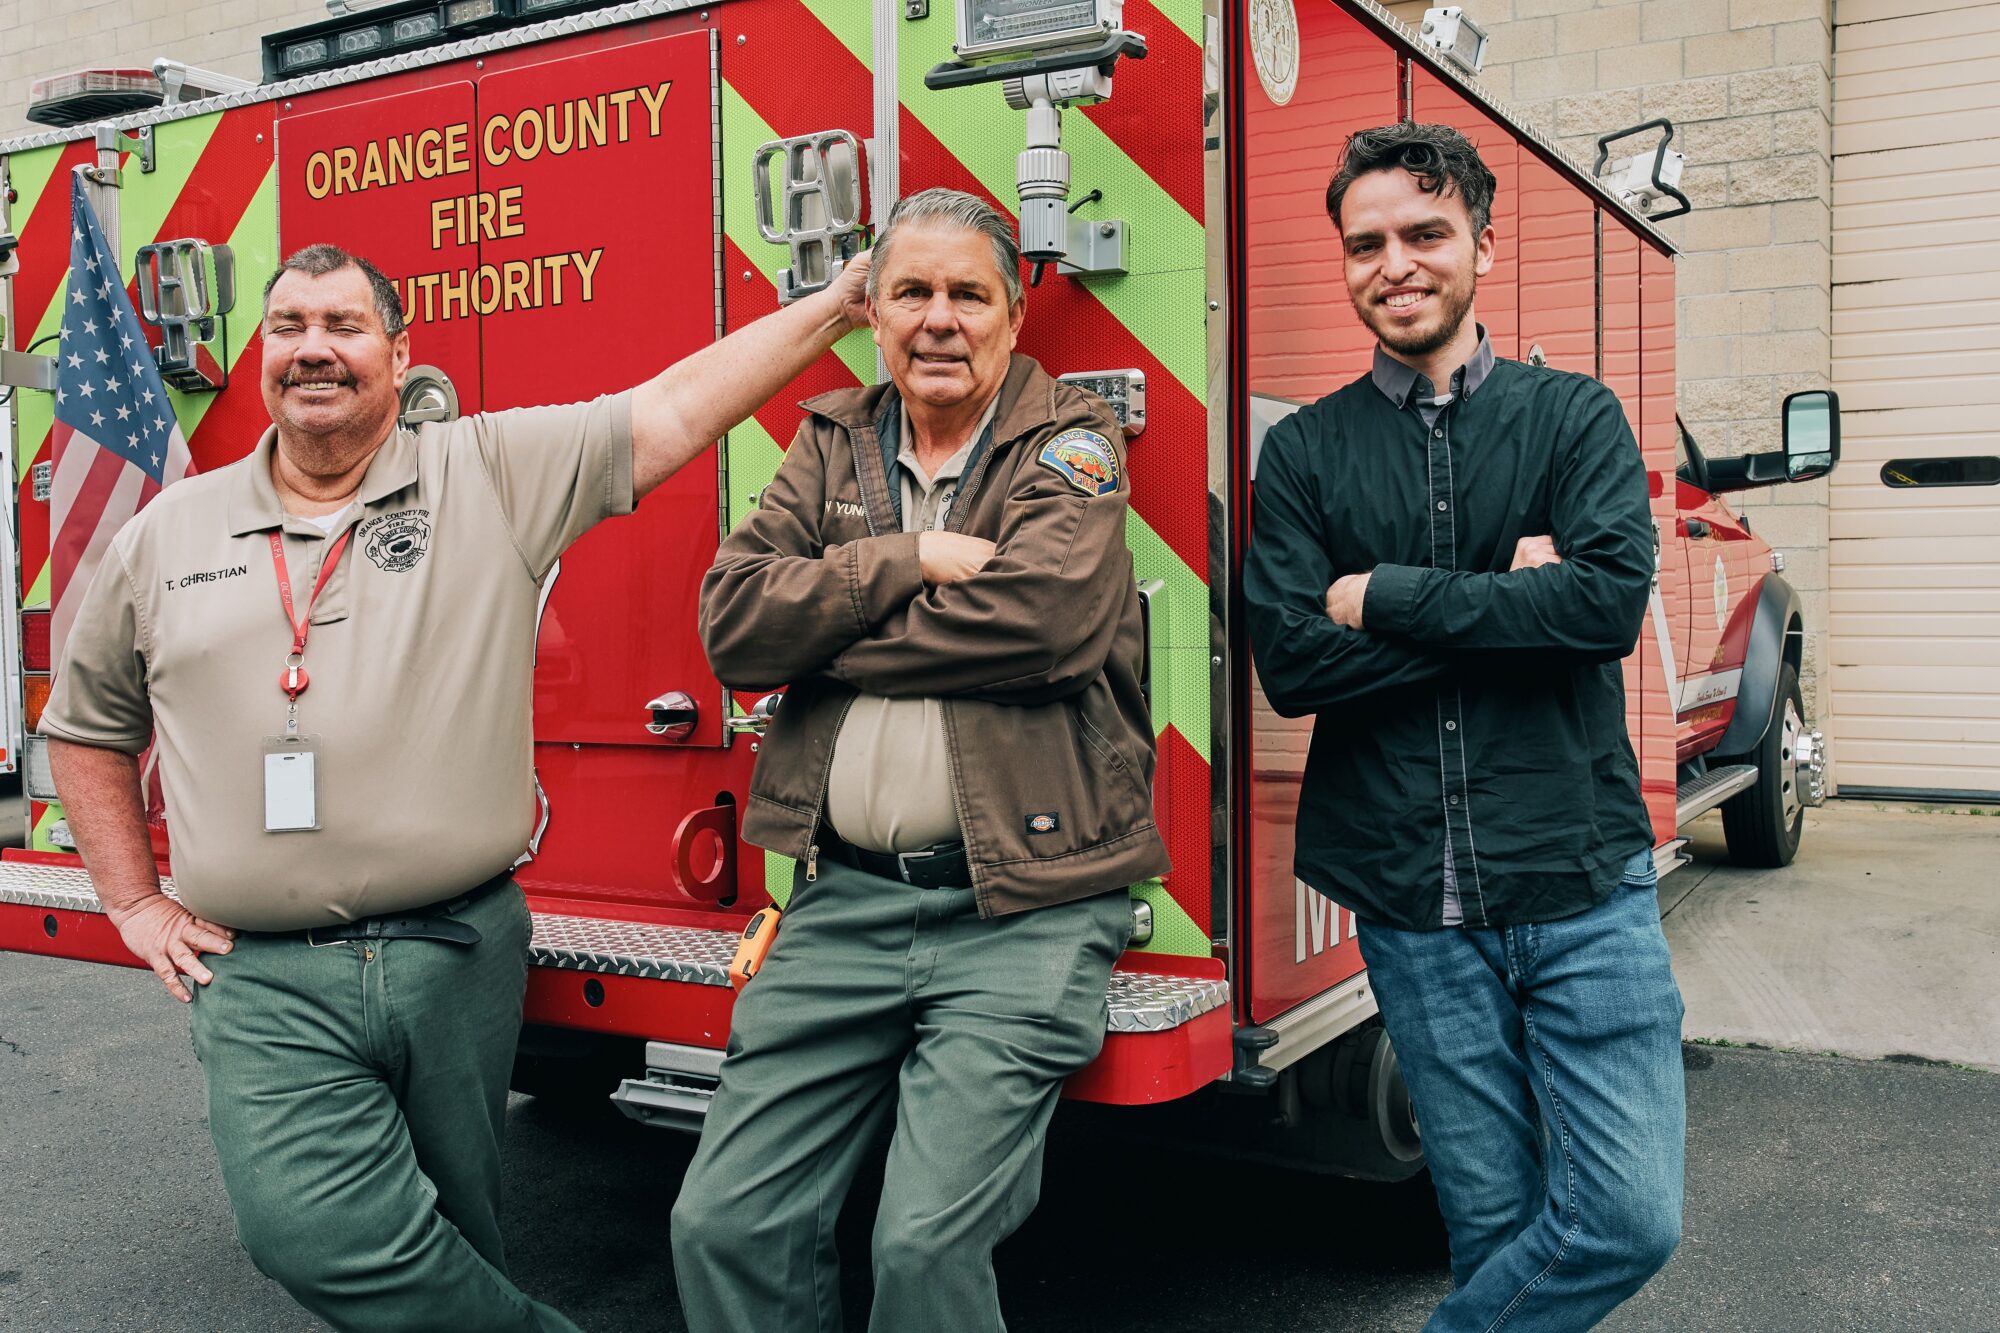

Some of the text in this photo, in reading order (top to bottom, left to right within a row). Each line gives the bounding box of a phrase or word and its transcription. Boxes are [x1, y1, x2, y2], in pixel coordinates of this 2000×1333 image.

[305, 80, 673, 200] ORANGE COUNTY
[430, 185, 526, 250] FIRE
[391, 247, 605, 327] UTHORITY
[1046, 431, 1119, 478] ORANGE COUNTY
[1073, 472, 1100, 494] FIRE
[358, 517, 384, 538] ORANGE
[385, 510, 417, 520] COUNTY
[388, 521, 405, 529] FIRE
[165, 564, 248, 592] T. CHRISTIAN
